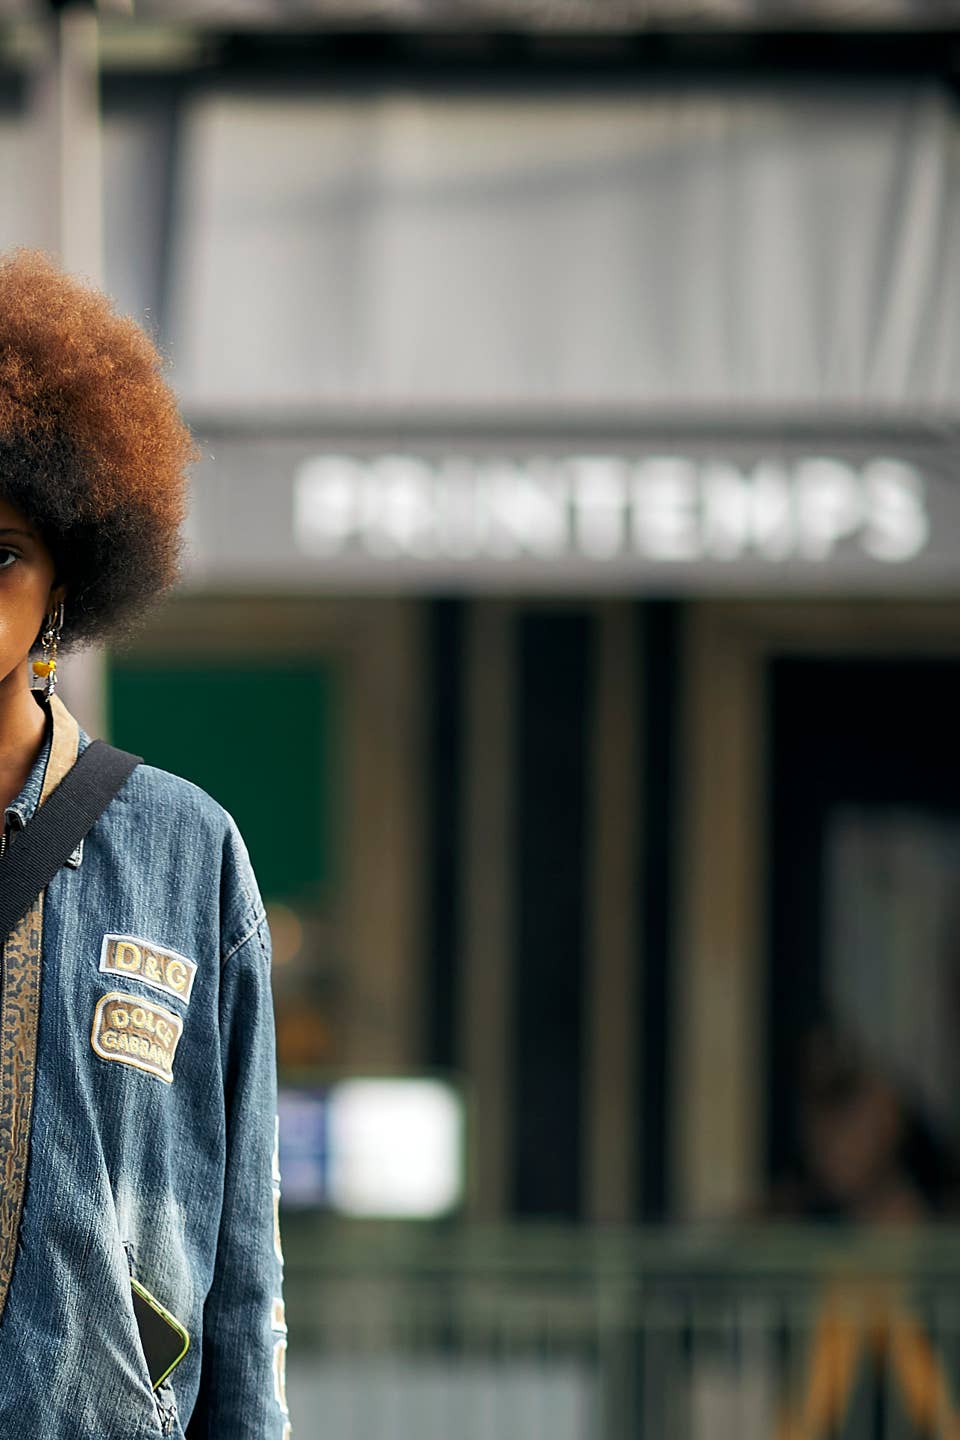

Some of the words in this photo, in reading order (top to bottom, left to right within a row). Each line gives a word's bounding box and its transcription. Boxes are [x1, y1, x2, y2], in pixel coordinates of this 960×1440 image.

[292, 454, 930, 564] PRINTEMPS
[114, 941, 189, 993] D&G
[110, 1008, 174, 1049] DOLCE
